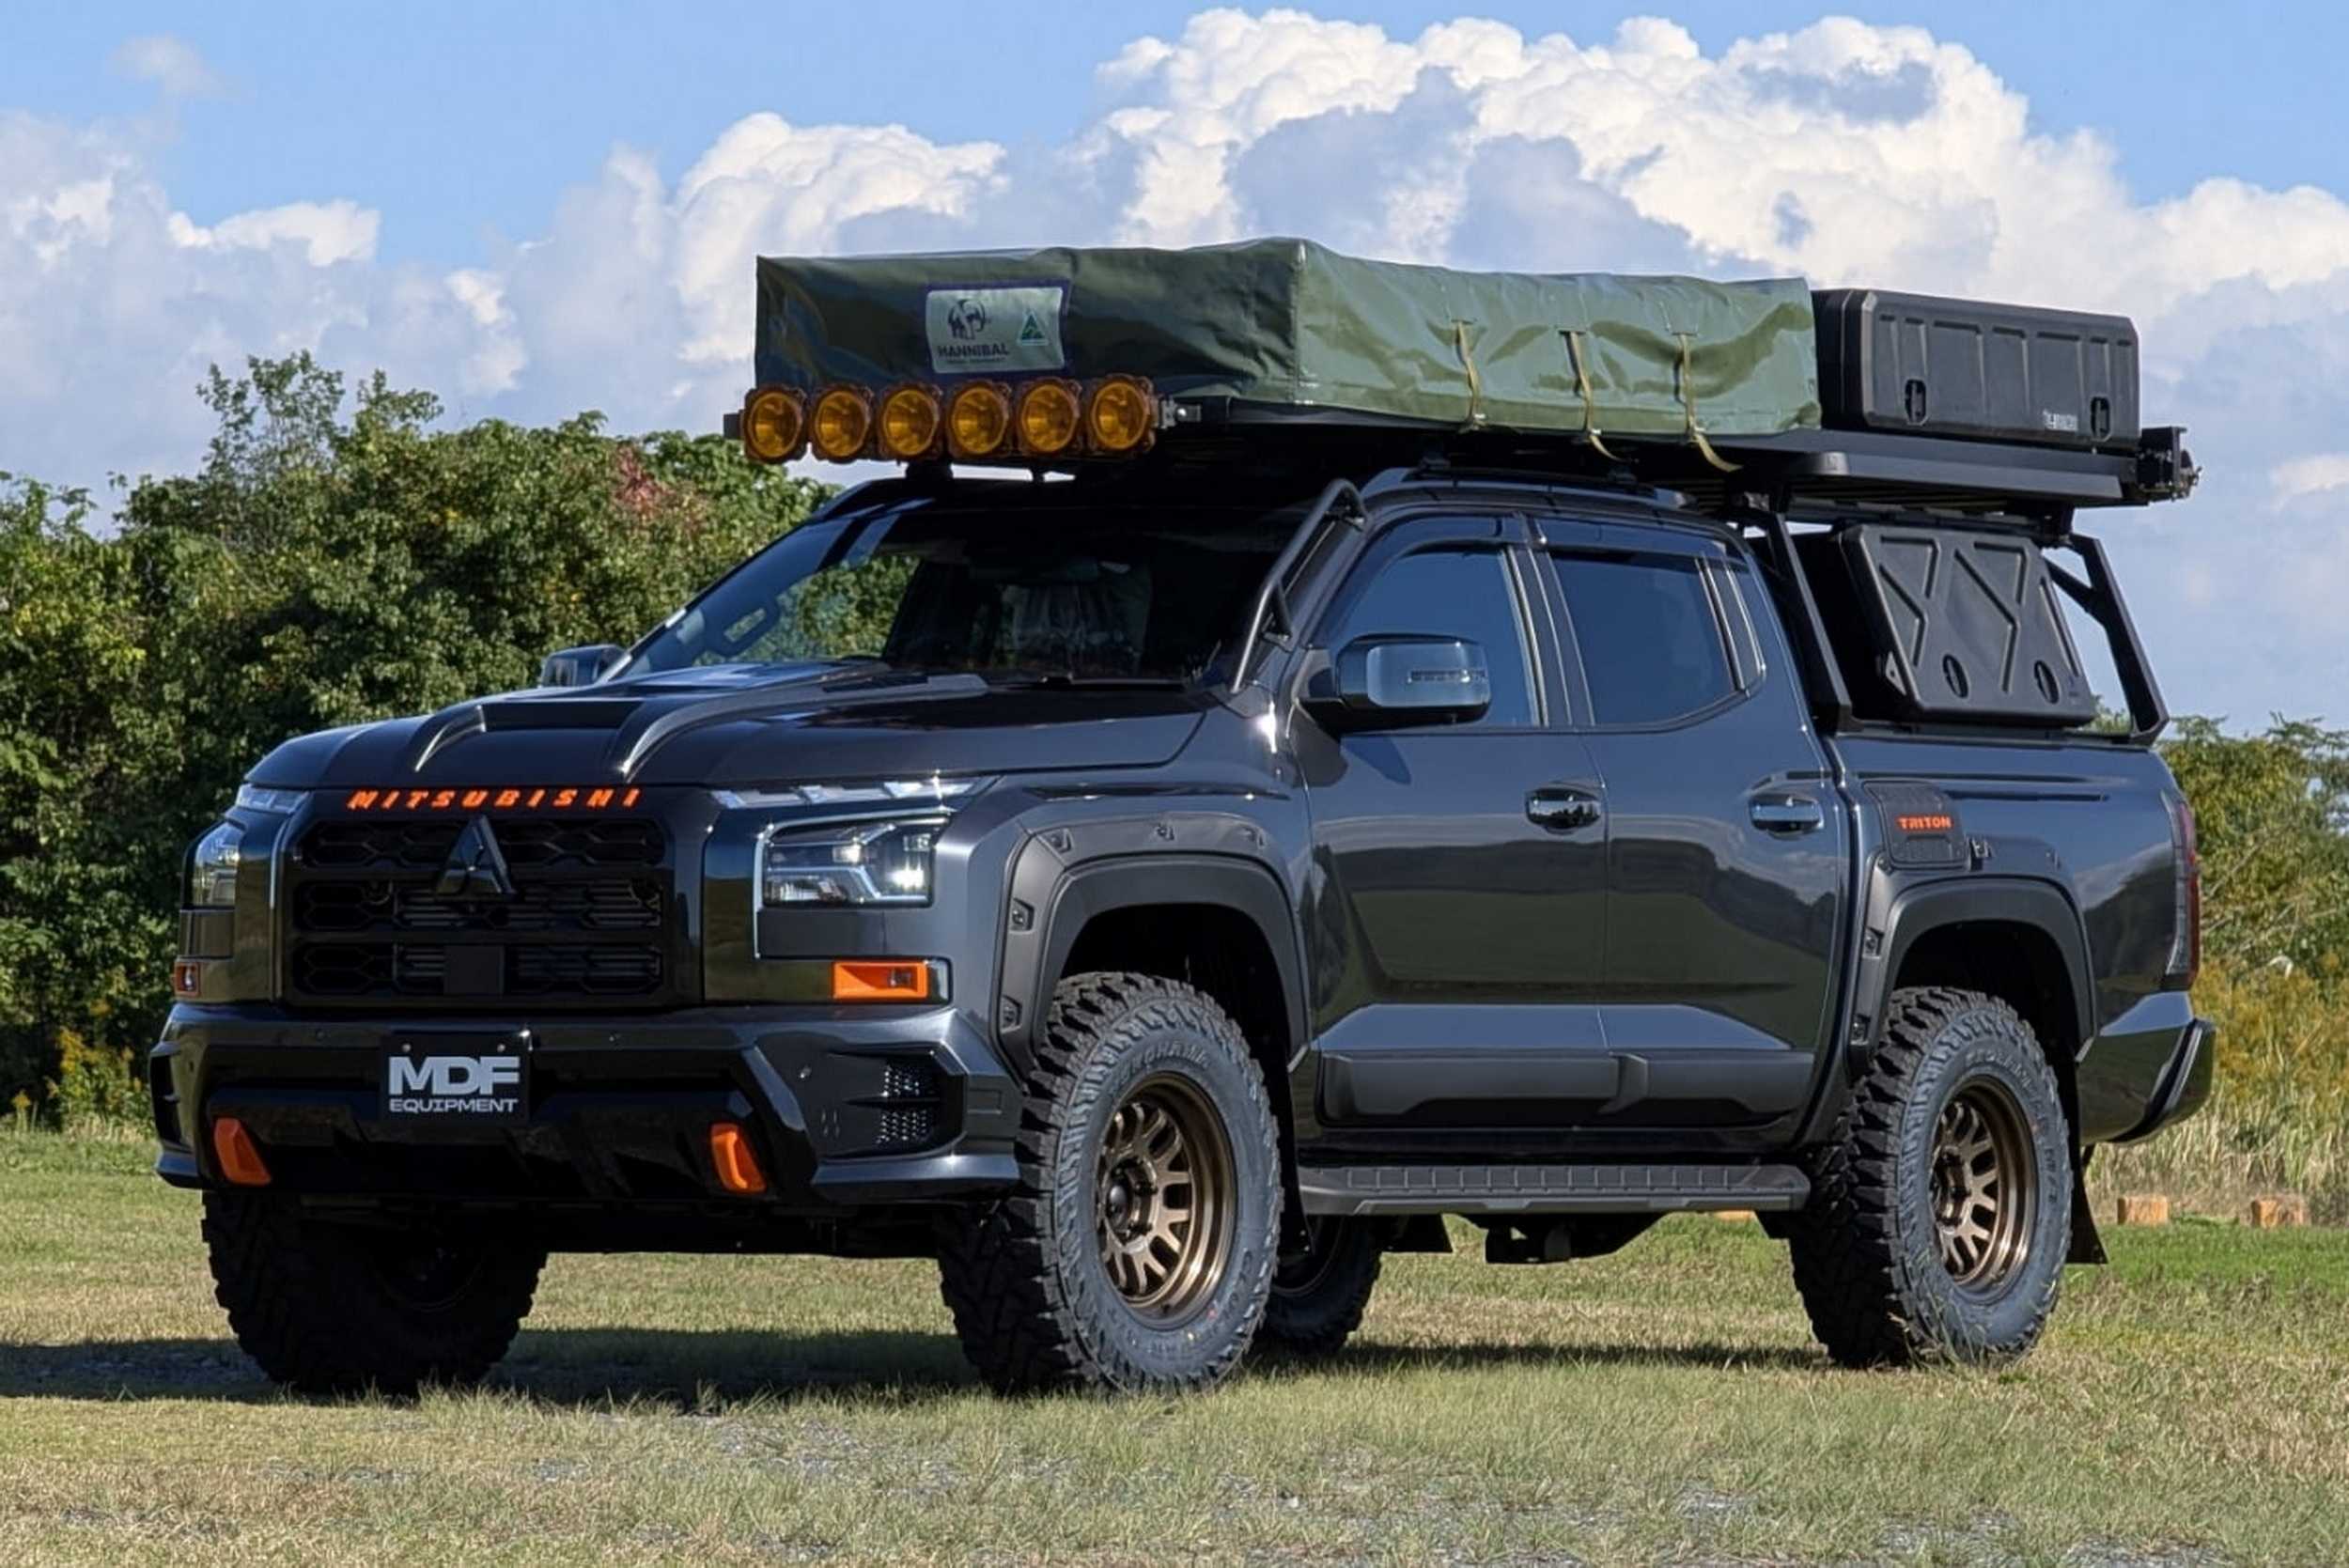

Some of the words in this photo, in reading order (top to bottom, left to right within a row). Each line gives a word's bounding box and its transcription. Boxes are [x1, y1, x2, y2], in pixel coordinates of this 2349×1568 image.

[938, 343, 1010, 358] HANNIBAL
[347, 788, 641, 810] MITSUBISHI
[1898, 815, 1952, 830] TRITON
[388, 1056, 521, 1096] MDF
[389, 1098, 519, 1114] EQUIPMENT
